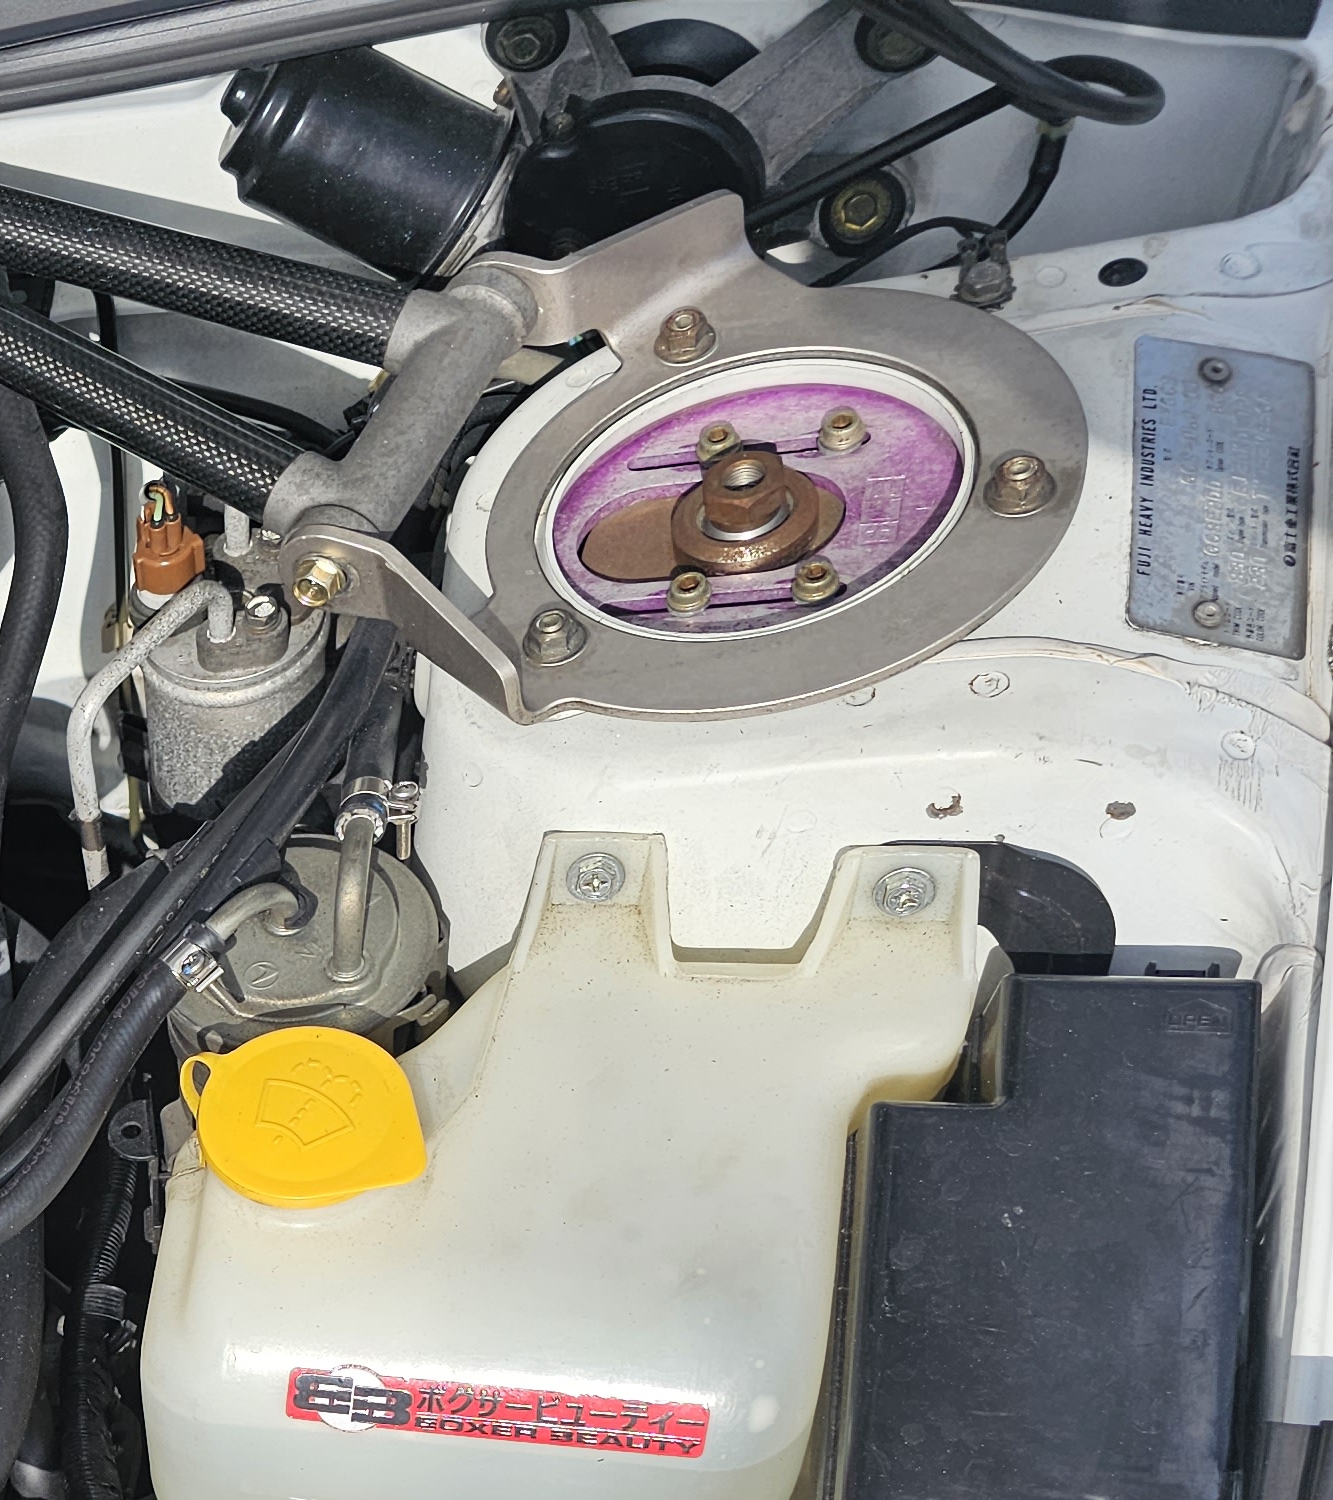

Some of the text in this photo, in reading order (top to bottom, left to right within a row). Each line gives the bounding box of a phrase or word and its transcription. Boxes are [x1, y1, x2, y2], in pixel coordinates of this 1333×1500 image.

[1136, 383, 1157, 575] FUJI HEAVY INDUSTRIES LTD.
[551, 1429, 701, 1453] BEAUTY
